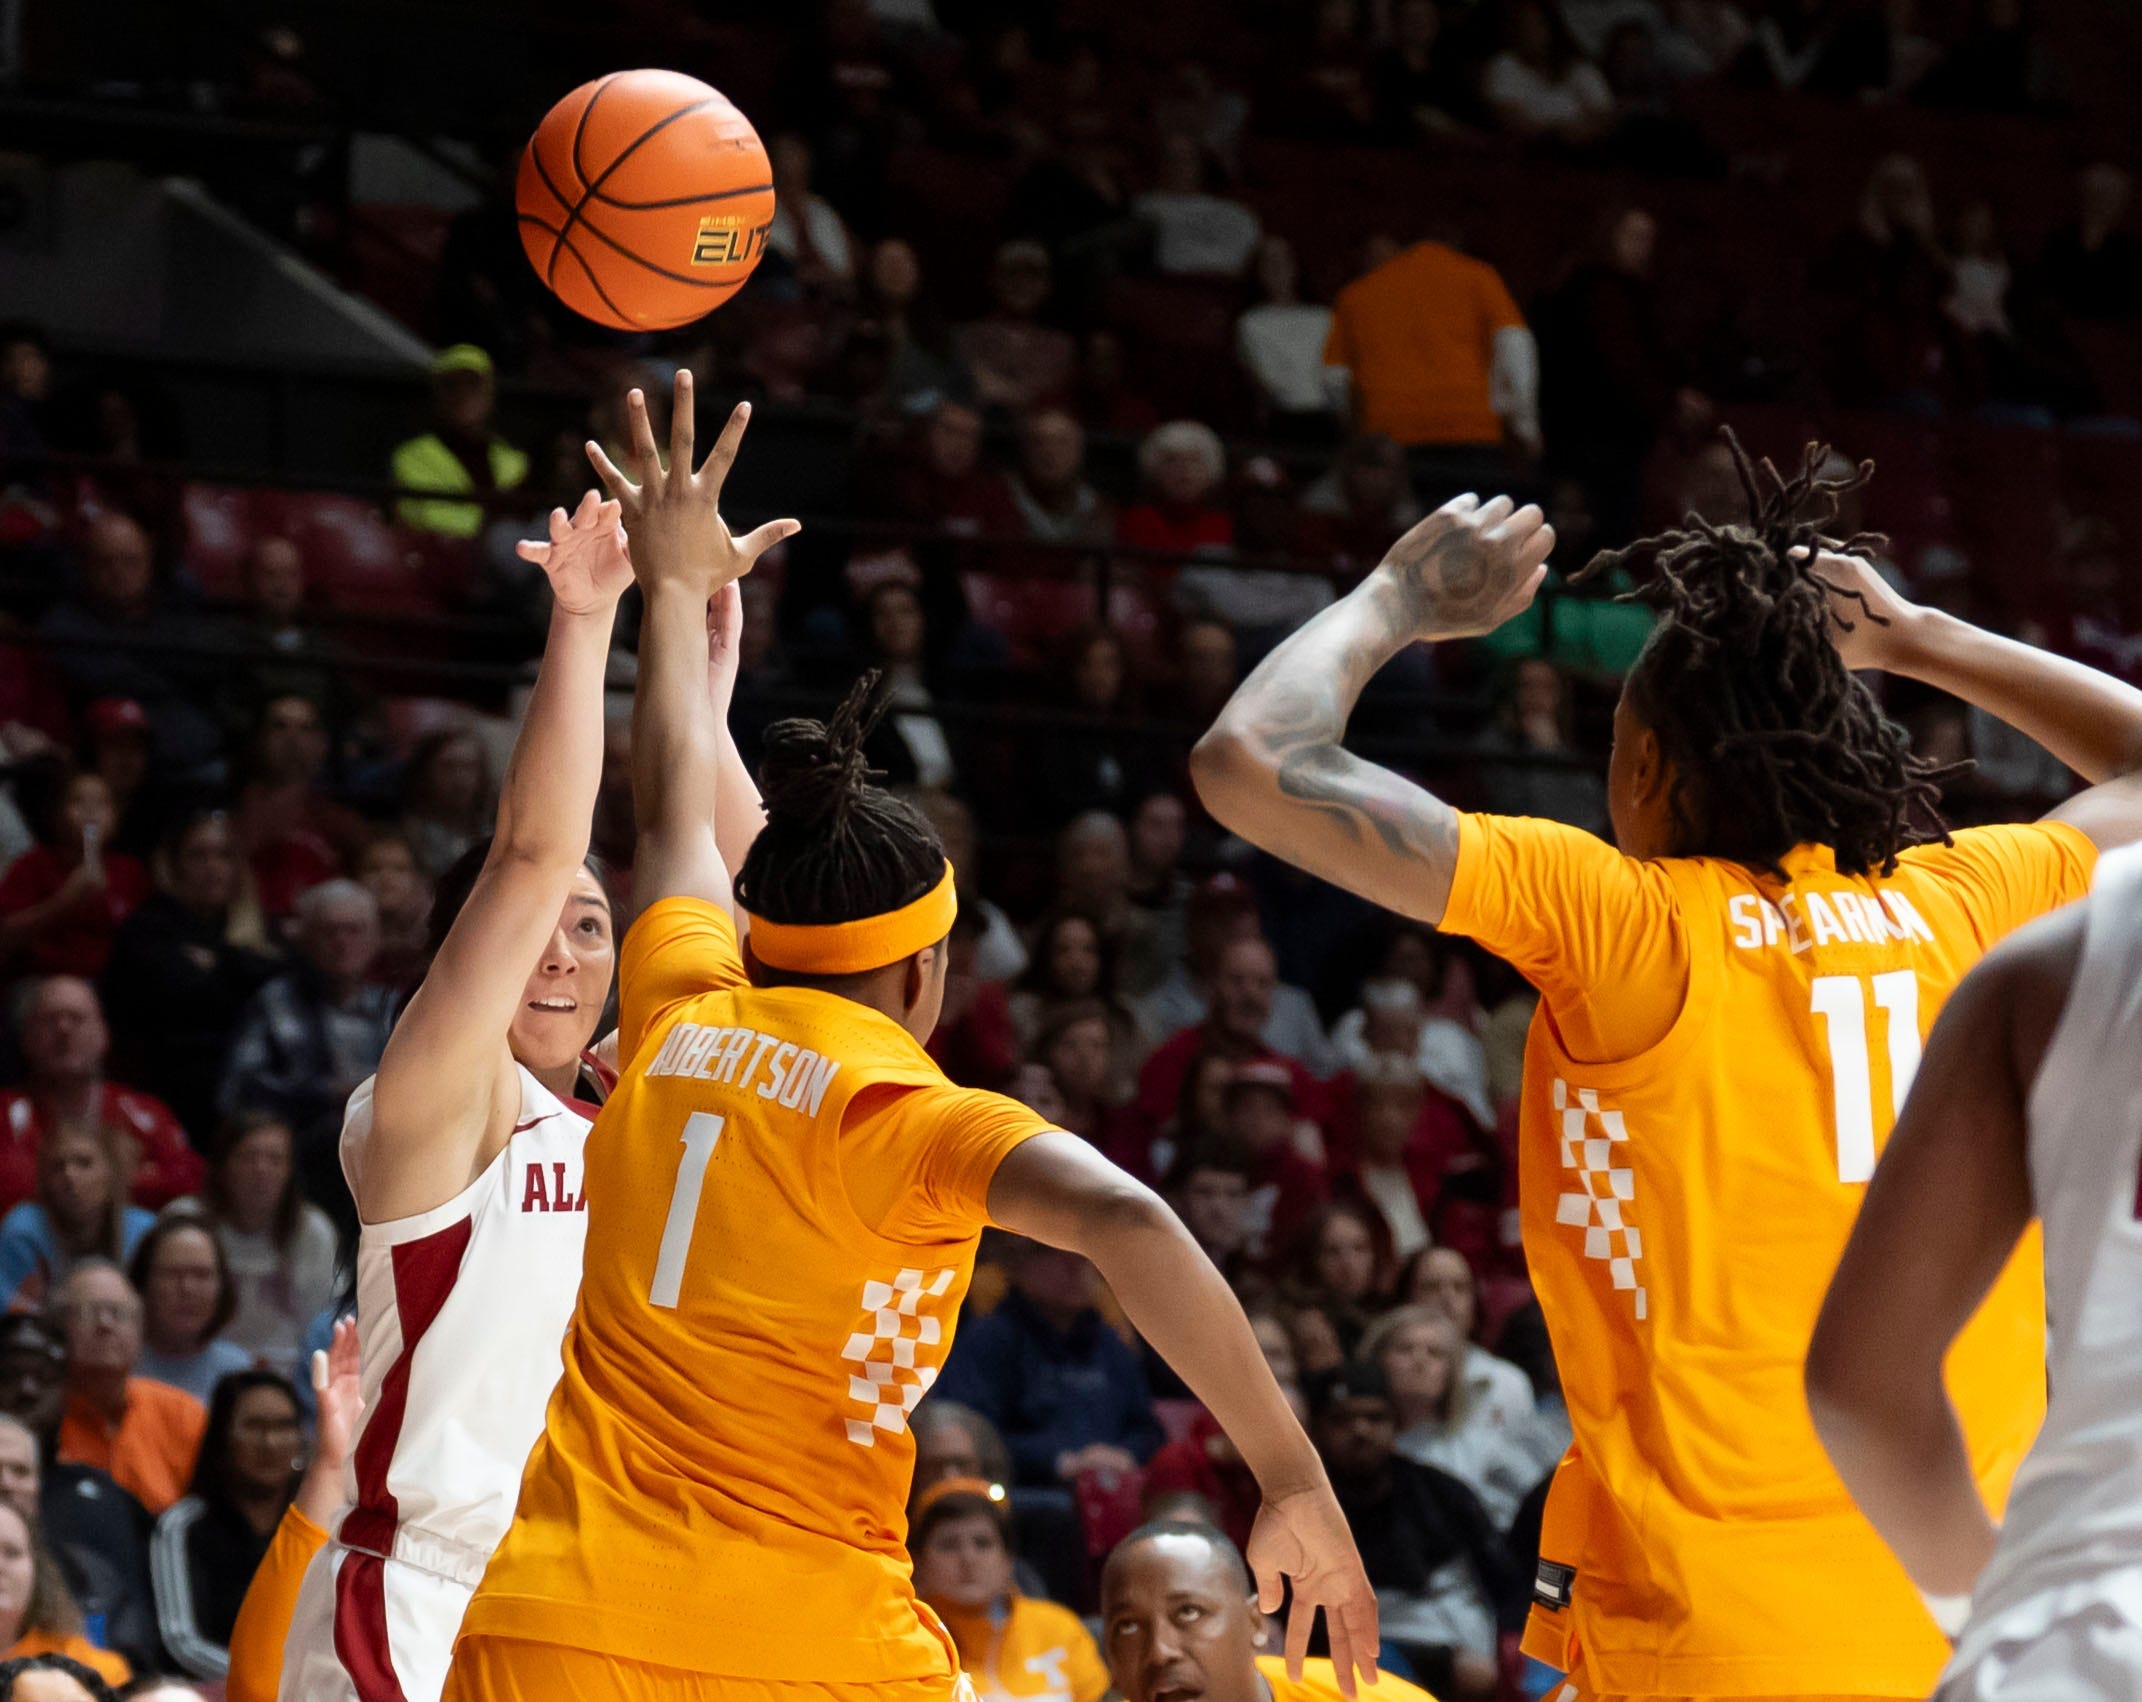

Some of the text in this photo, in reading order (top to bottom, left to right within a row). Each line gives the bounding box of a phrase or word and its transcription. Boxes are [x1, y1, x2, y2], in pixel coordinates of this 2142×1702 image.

[691, 225, 769, 266] ELIT
[1810, 969, 1923, 1184] 11
[648, 1111, 725, 1309] 1
